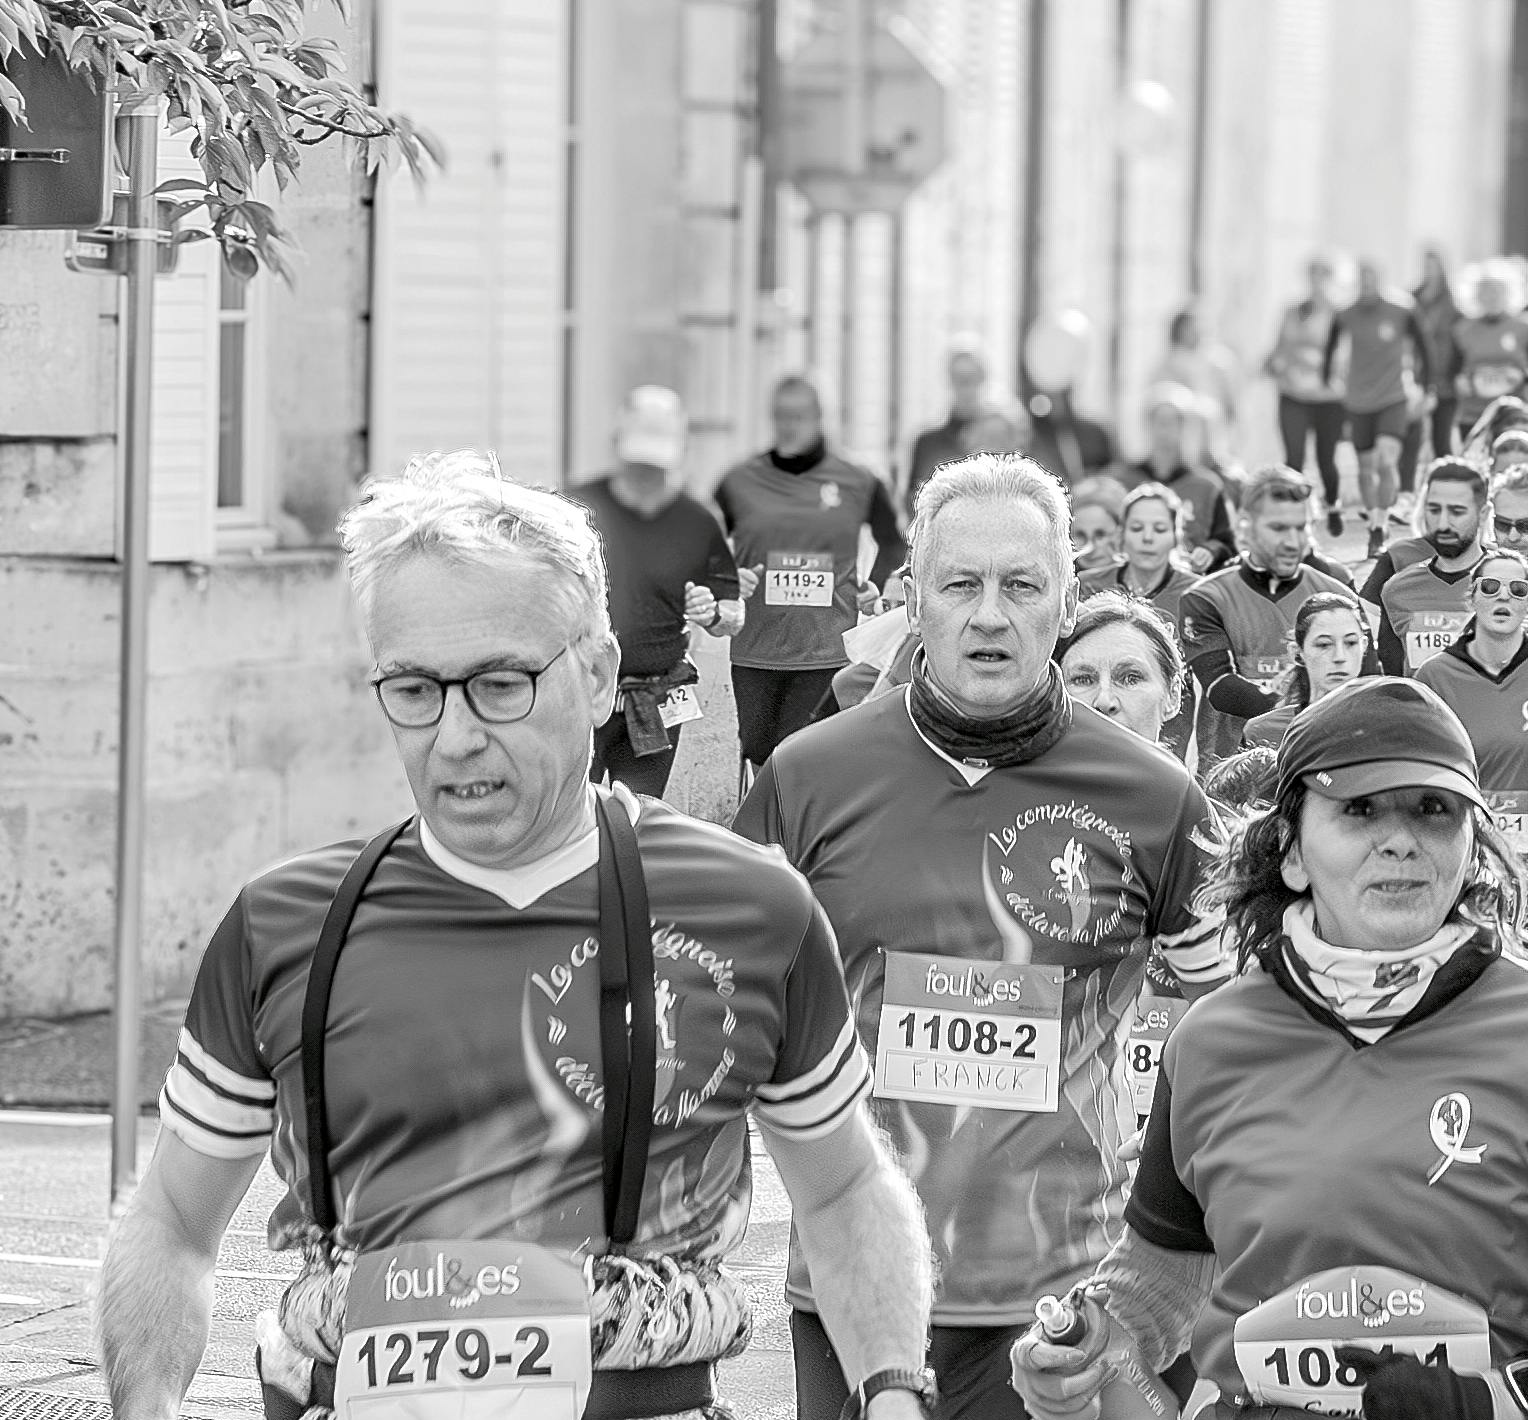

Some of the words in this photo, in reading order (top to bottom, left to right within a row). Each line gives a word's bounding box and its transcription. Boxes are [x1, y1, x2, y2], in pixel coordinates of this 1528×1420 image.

[773, 573, 825, 588] 1119-2
[898, 1012, 1038, 1060] 1108-2
[913, 1057, 1031, 1091] FRANCK
[1296, 1277, 1427, 1329] foul&es
[357, 1326, 552, 1388] 1279-2
